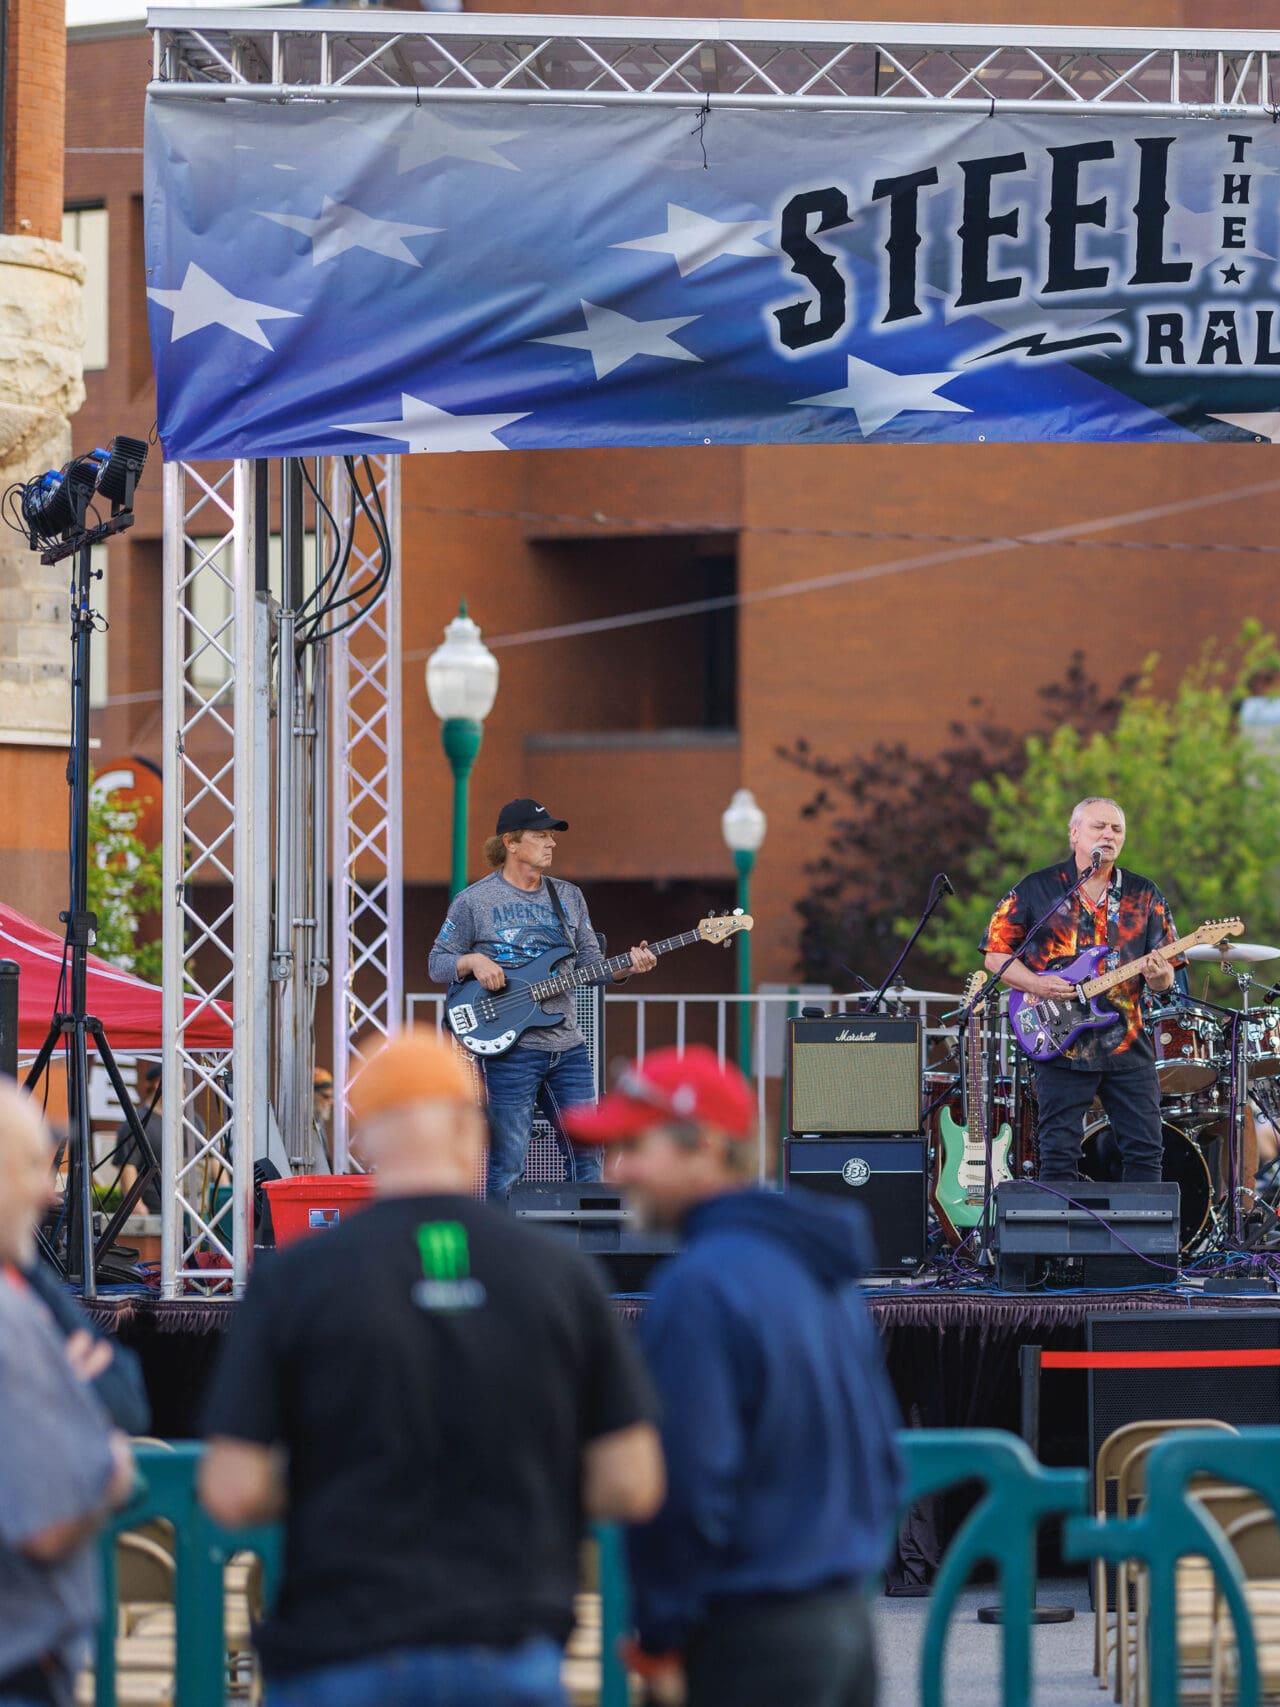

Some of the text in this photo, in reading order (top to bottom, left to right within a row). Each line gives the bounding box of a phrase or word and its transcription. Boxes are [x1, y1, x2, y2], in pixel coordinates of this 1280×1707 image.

[773, 136, 1193, 351] STEEL
[1222, 134, 1253, 249] THE
[835, 1029, 877, 1042] Marshall
